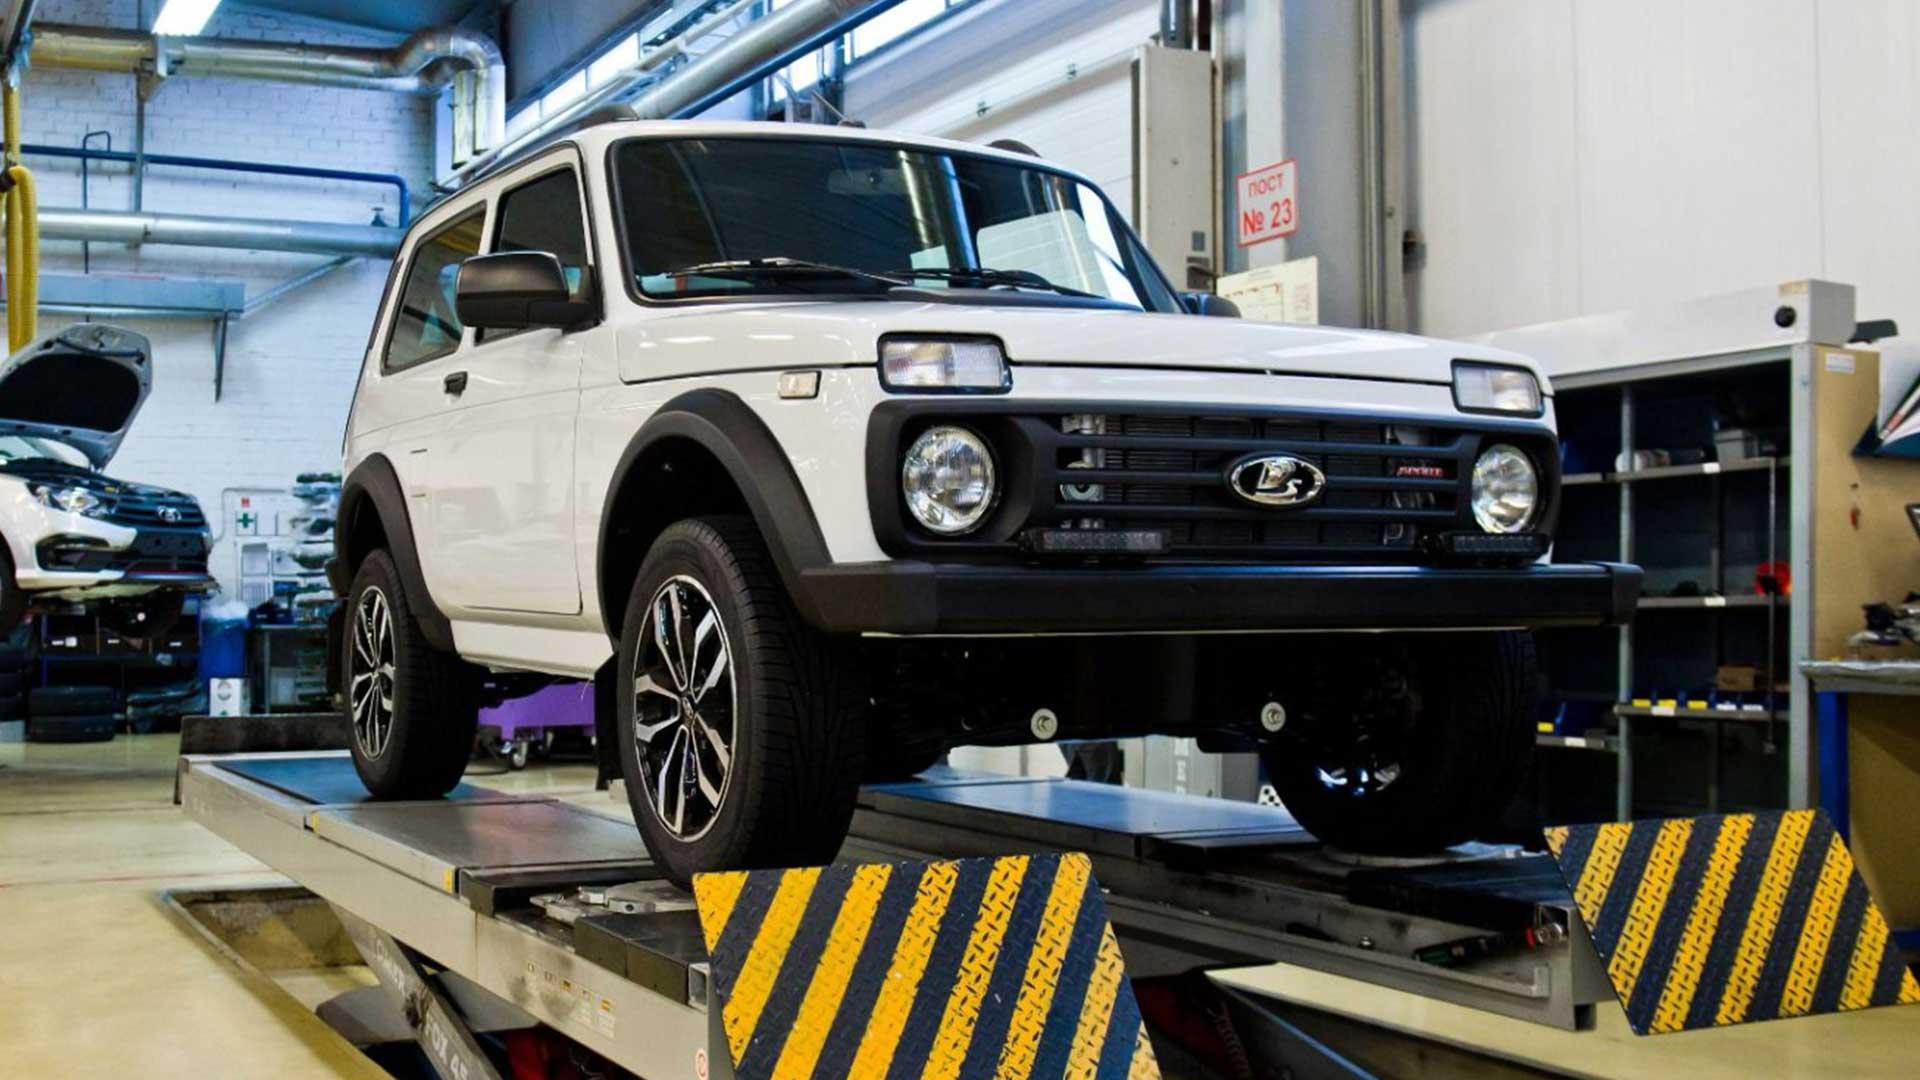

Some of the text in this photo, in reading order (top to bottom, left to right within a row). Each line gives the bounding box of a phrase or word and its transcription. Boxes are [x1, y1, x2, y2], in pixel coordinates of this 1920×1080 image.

[1249, 172, 1283, 197] ПОСТ
[1243, 198, 1292, 236] № 23
